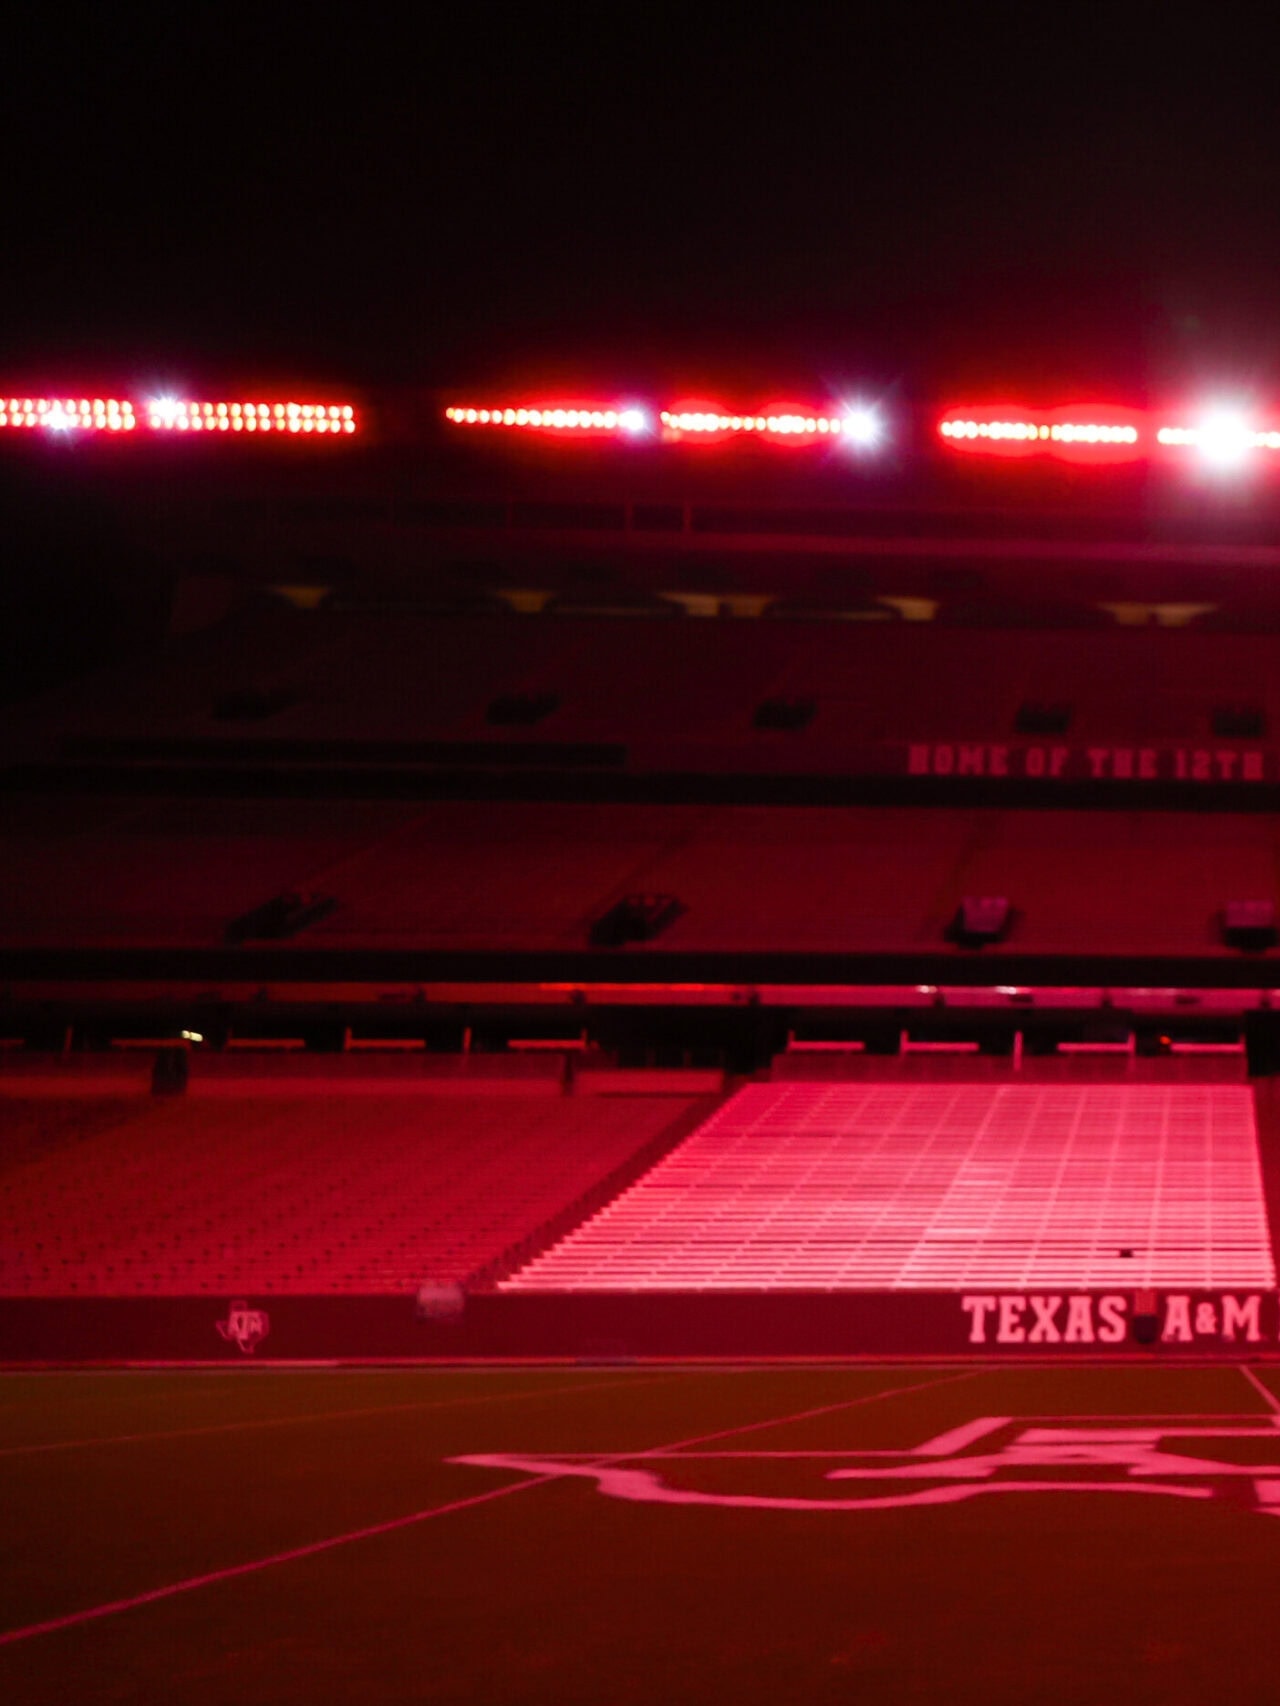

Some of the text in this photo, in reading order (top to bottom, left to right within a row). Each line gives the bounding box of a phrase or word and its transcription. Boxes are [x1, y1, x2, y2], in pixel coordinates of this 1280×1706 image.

[908, 743, 1008, 776] HOME
[1025, 747, 1069, 777] OF
[1086, 747, 1157, 779] THE
[1174, 749, 1264, 782] 12TH
[962, 1294, 1127, 1343] TEXAS
[1161, 1294, 1262, 1342] A&M
